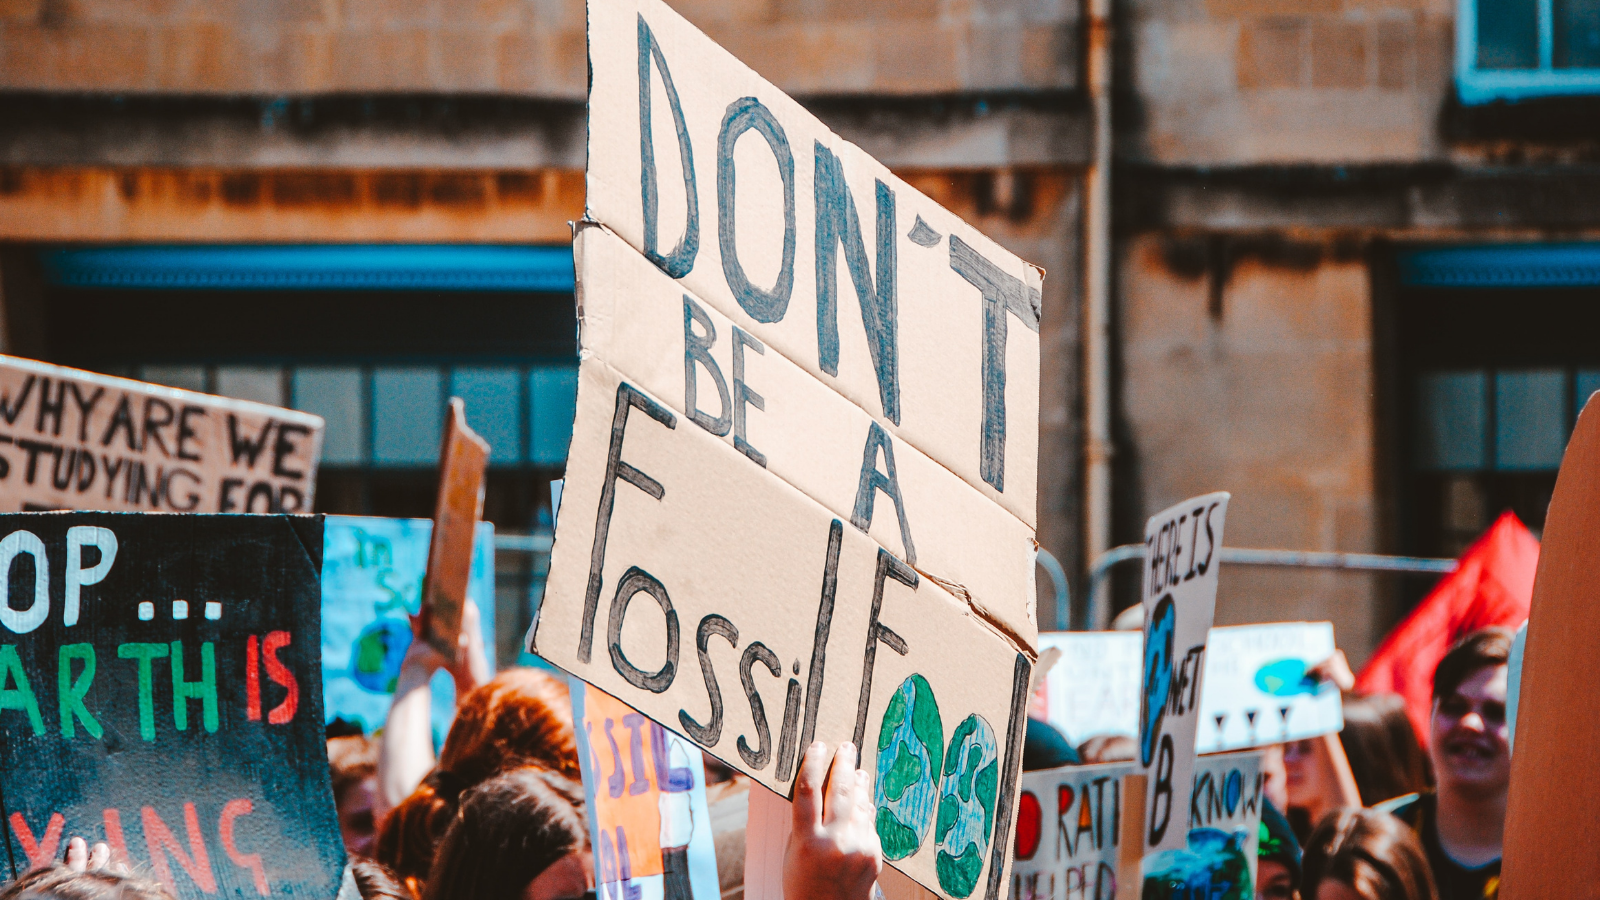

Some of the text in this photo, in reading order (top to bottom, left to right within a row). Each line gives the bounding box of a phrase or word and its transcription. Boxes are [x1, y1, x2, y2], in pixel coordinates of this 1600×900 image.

[636, 11, 1041, 493] DON'T
[101, 392, 205, 460] ARE
[227, 411, 312, 479] WE
[683, 293, 917, 567] BE A
[246, 630, 299, 725] IS
[1148, 733, 1174, 845] B
[1189, 768, 1264, 829] KNOW
